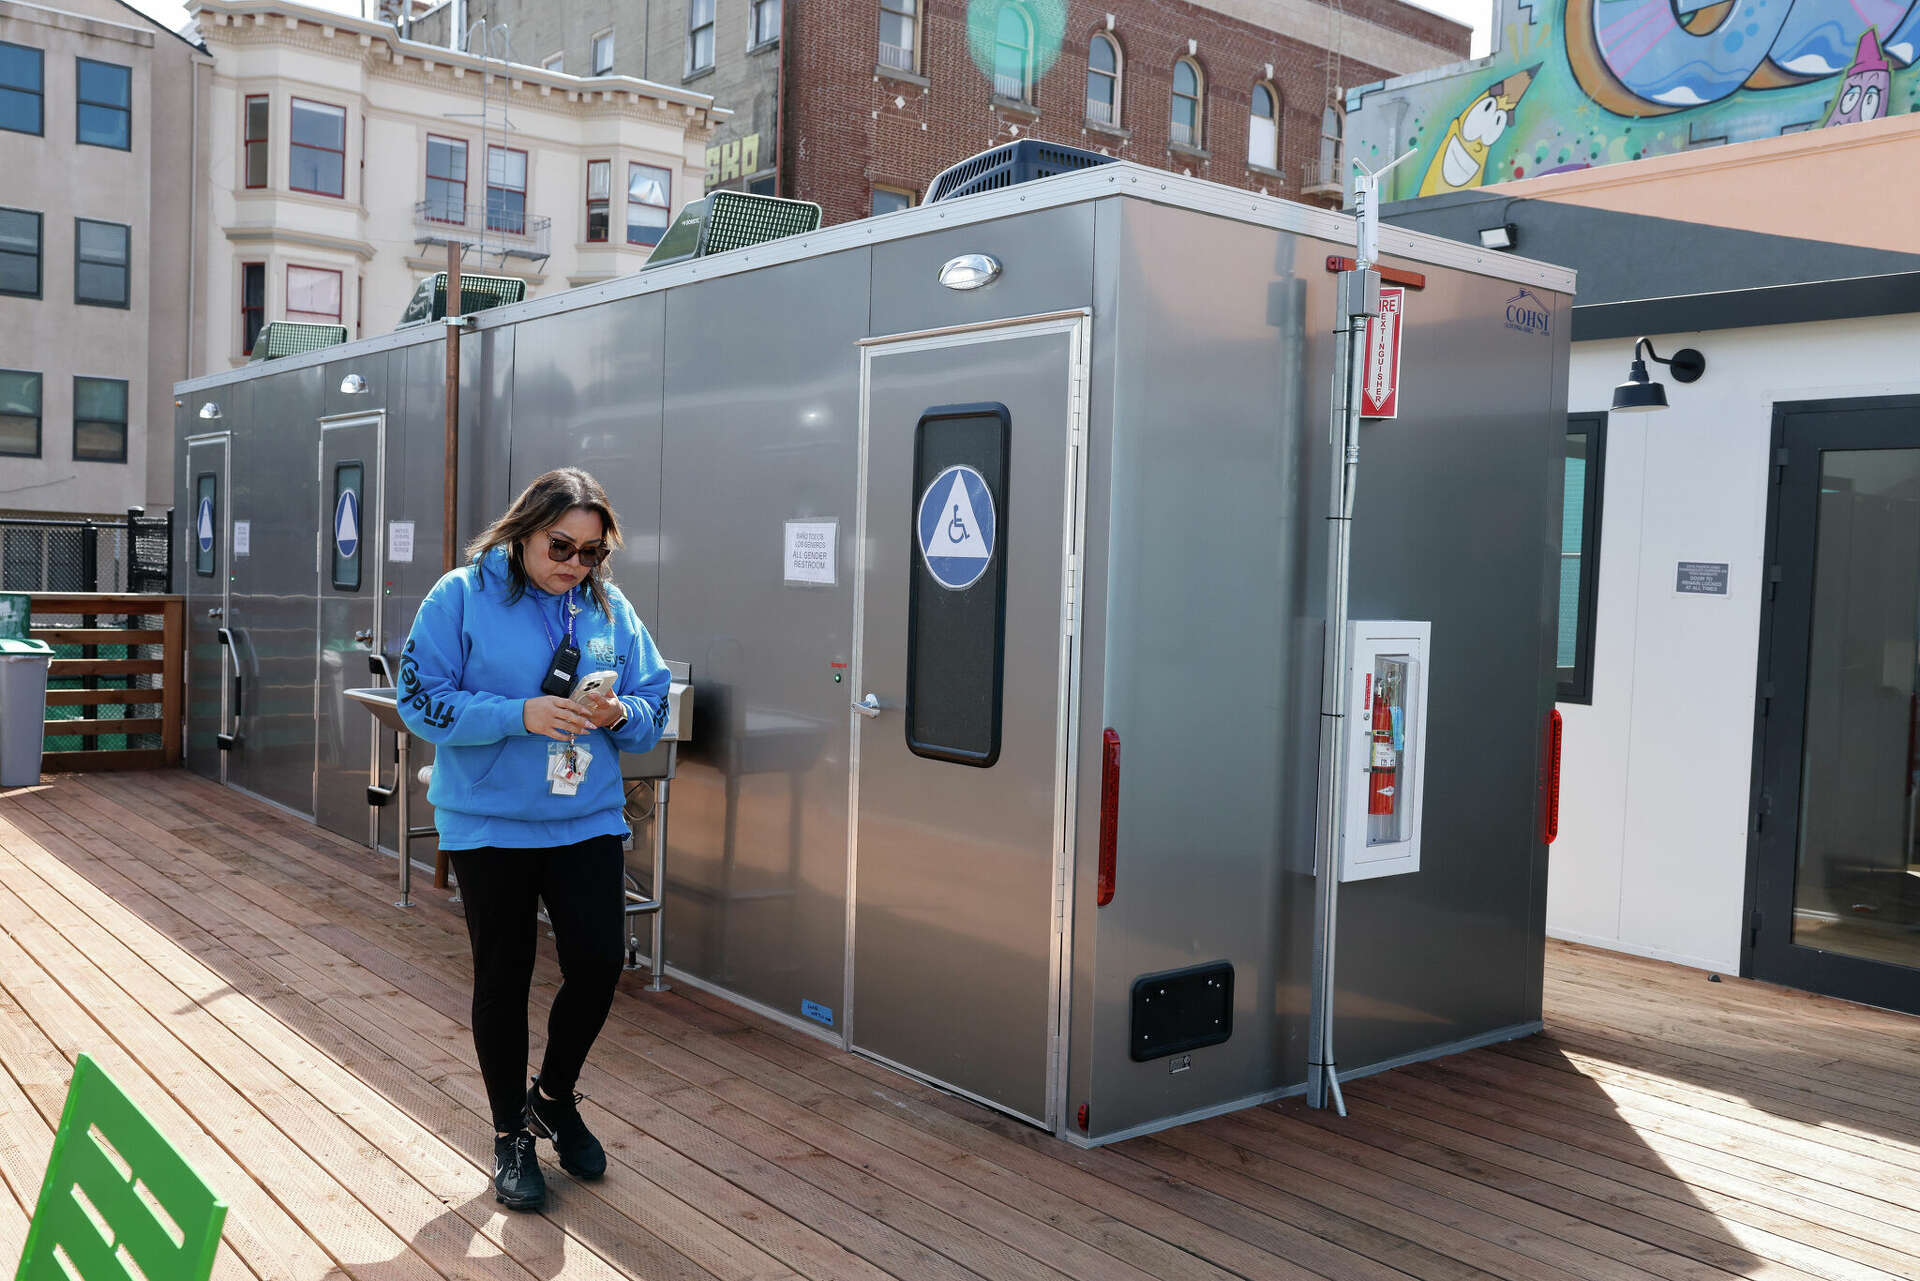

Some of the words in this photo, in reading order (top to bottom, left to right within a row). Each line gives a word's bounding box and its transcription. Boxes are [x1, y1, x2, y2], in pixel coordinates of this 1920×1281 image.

[1379, 298, 1396, 313] IRE
[1375, 312, 1387, 403] EXTINGUISHER
[792, 550, 803, 559] ALL
[804, 551, 827, 560] GENDER
